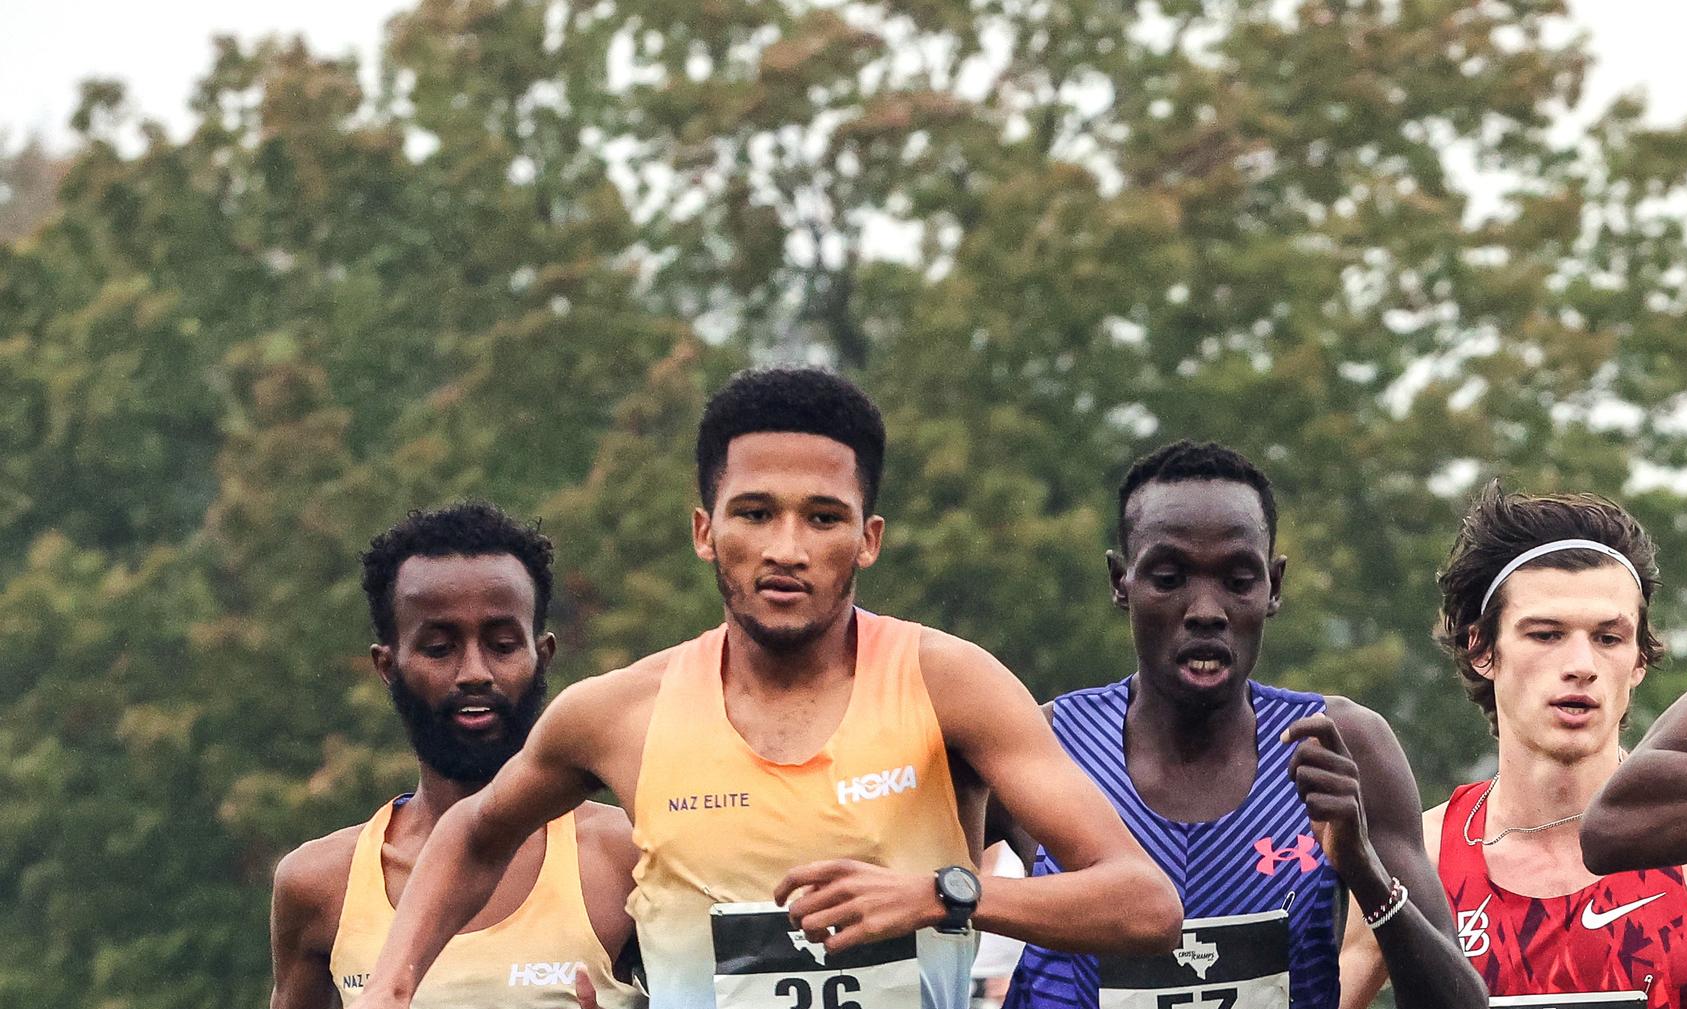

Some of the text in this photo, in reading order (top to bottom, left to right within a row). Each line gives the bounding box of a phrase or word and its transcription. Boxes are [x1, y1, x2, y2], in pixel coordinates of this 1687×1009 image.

[837, 765, 918, 805] HOKA
[668, 793, 751, 812] NAZ ELITE
[343, 974, 363, 989] NAZ
